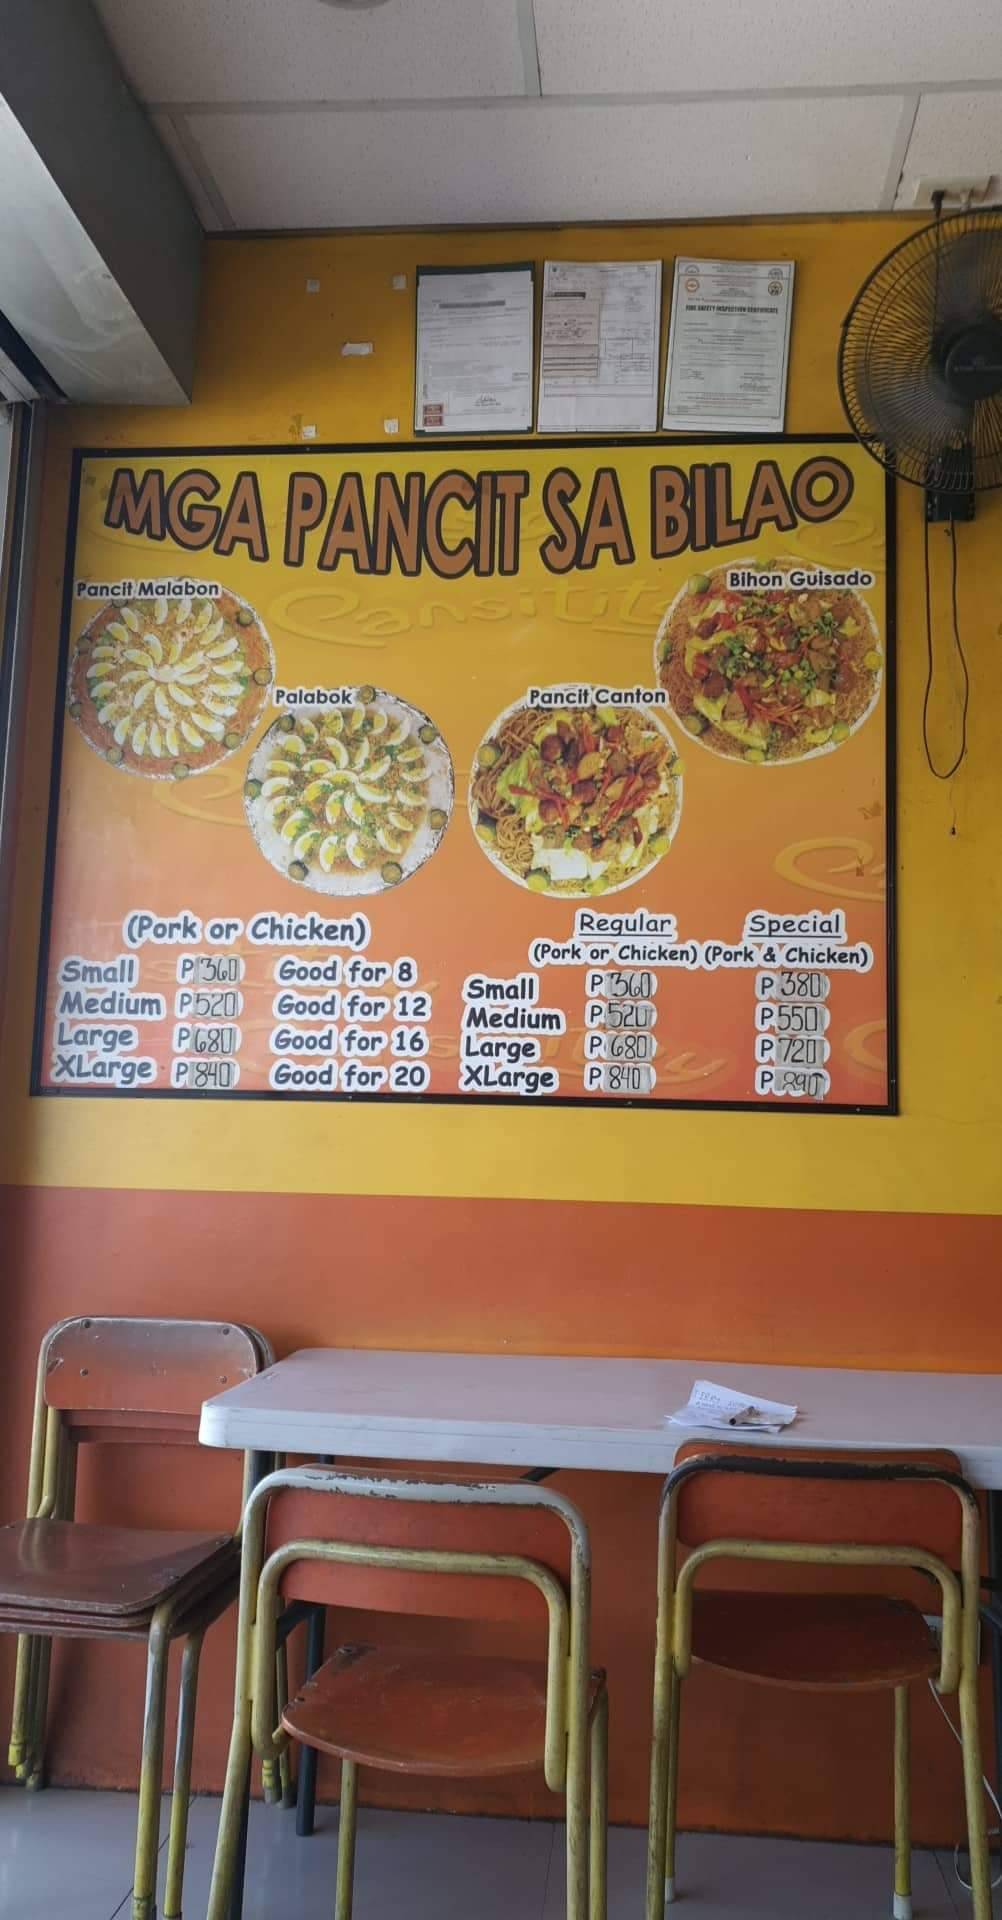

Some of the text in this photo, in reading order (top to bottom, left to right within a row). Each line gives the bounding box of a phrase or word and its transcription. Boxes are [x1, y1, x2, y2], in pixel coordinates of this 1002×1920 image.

[104, 455, 854, 579] MGA PANCIT SA BILAO
[77, 581, 219, 598] Pancit Malabon
[729, 570, 872, 588] Bihon Guisado
[276, 689, 353, 704] Palabok
[530, 688, 666, 705] Pancit Canton
[127, 915, 366, 946] (Pork or Chicken)
[579, 913, 672, 937] Regular
[749, 914, 840, 938] Special
[534, 943, 697, 964] (Pork or Chicken)
[705, 946, 868, 967] (Pork & Chicken)
[61, 959, 134, 983] Small
[279, 960, 337, 981] Good
[349, 961, 387, 983] for
[398, 962, 413, 982] 8
[467, 978, 534, 1000] Small
[59, 991, 161, 1015] Medium
[277, 994, 336, 1015] Good
[347, 995, 385, 1017] for
[398, 996, 427, 1017] 12
[466, 1007, 561, 1030] Medium
[57, 1022, 133, 1052] Large
[274, 1029, 333, 1050] Good
[344, 1030, 382, 1052] for
[395, 1030, 424, 1052] 16
[465, 1036, 535, 1063] Large
[55, 1054, 152, 1085] XLarge
[274, 1064, 333, 1085] Good
[344, 1065, 383, 1087] for
[395, 1066, 425, 1087] 20
[464, 1065, 554, 1093] XLarge
